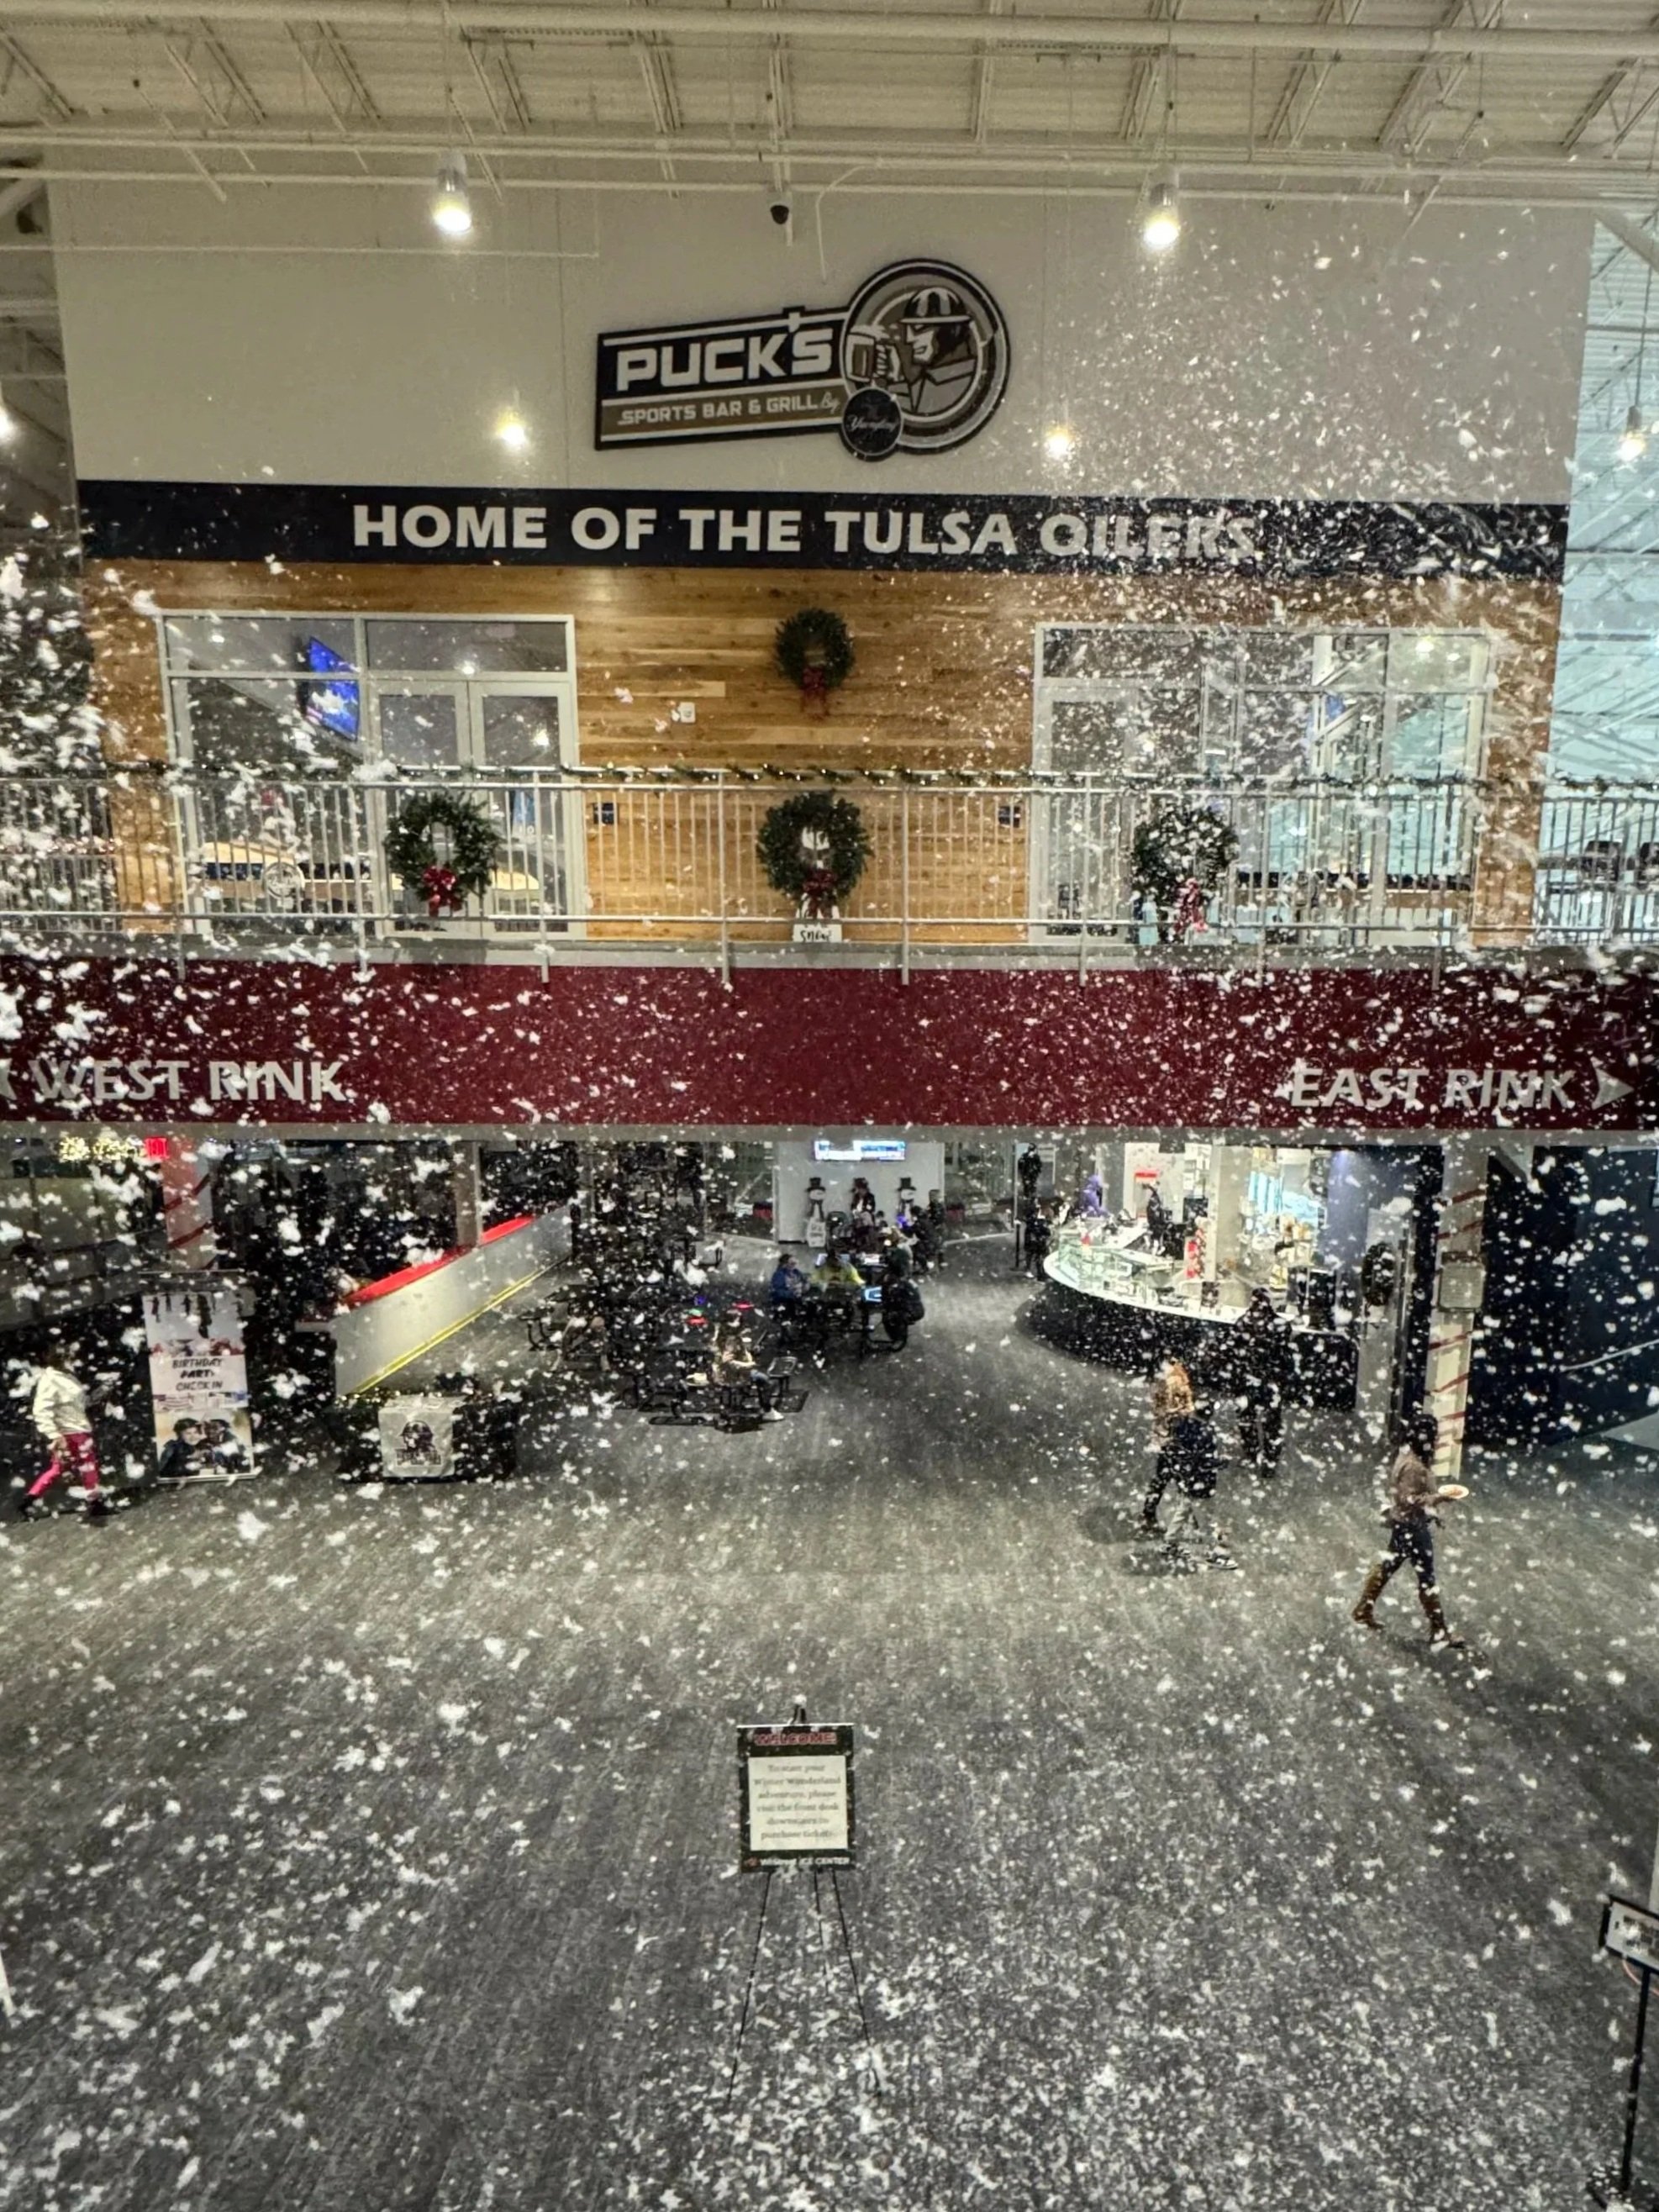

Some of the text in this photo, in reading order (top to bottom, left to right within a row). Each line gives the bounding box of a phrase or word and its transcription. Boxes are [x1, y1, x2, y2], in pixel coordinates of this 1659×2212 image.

[616, 313, 834, 392] PUCK'S
[617, 403, 697, 426] SPORTS
[703, 400, 744, 419] BAR
[748, 400, 761, 415] &
[766, 394, 818, 413] GRILL
[353, 504, 1256, 560] HOME OF THE TULSA OILERS
[28, 1060, 347, 1102] WEST RINK
[1291, 1067, 1576, 1109] EAST RINK
[172, 1358, 223, 1369] BIRTHDAY
[755, 1732, 837, 1746] WELCOME
